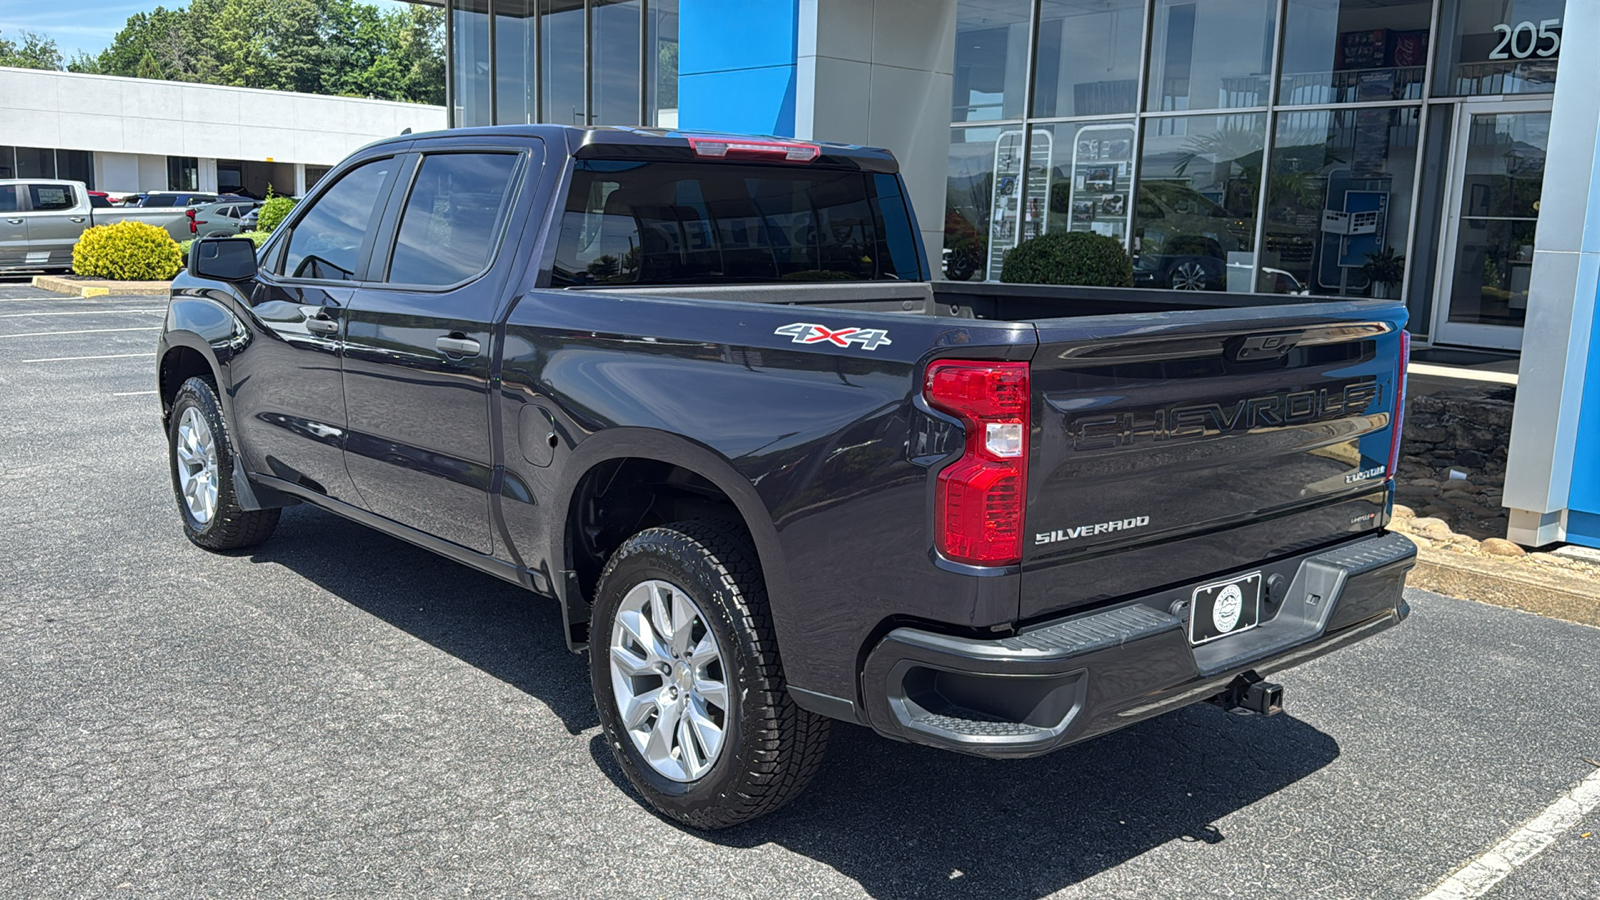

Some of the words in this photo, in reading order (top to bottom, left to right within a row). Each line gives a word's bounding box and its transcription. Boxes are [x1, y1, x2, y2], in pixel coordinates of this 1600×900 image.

[1488, 18, 1561, 60] 205
[1345, 465, 1386, 484] CUSTOM
[1035, 515, 1150, 546] SILVERADO
